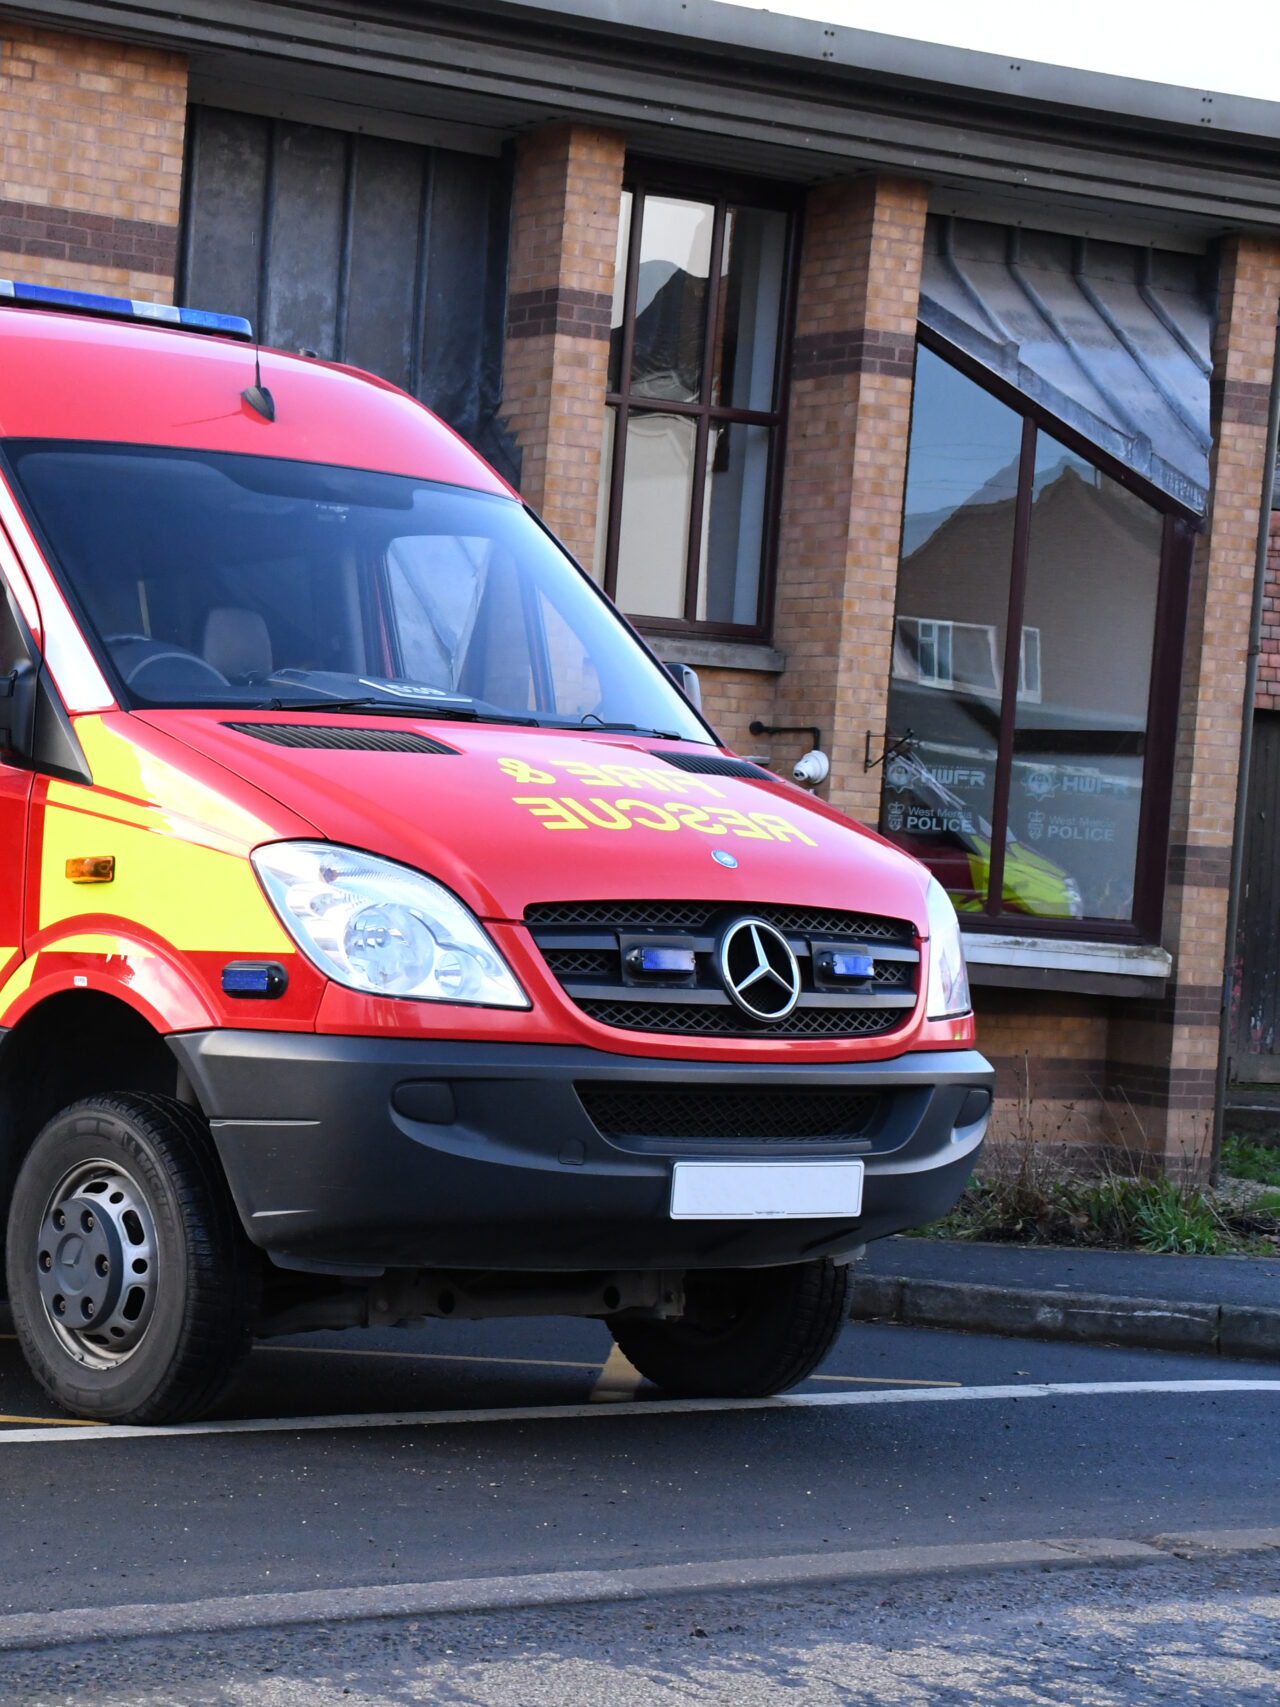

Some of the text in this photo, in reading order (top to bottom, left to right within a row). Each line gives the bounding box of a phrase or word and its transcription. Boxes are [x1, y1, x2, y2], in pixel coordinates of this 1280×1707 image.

[907, 806, 935, 817] West
[906, 816, 974, 833] POLICE
[1047, 825, 1114, 842] POLICE
